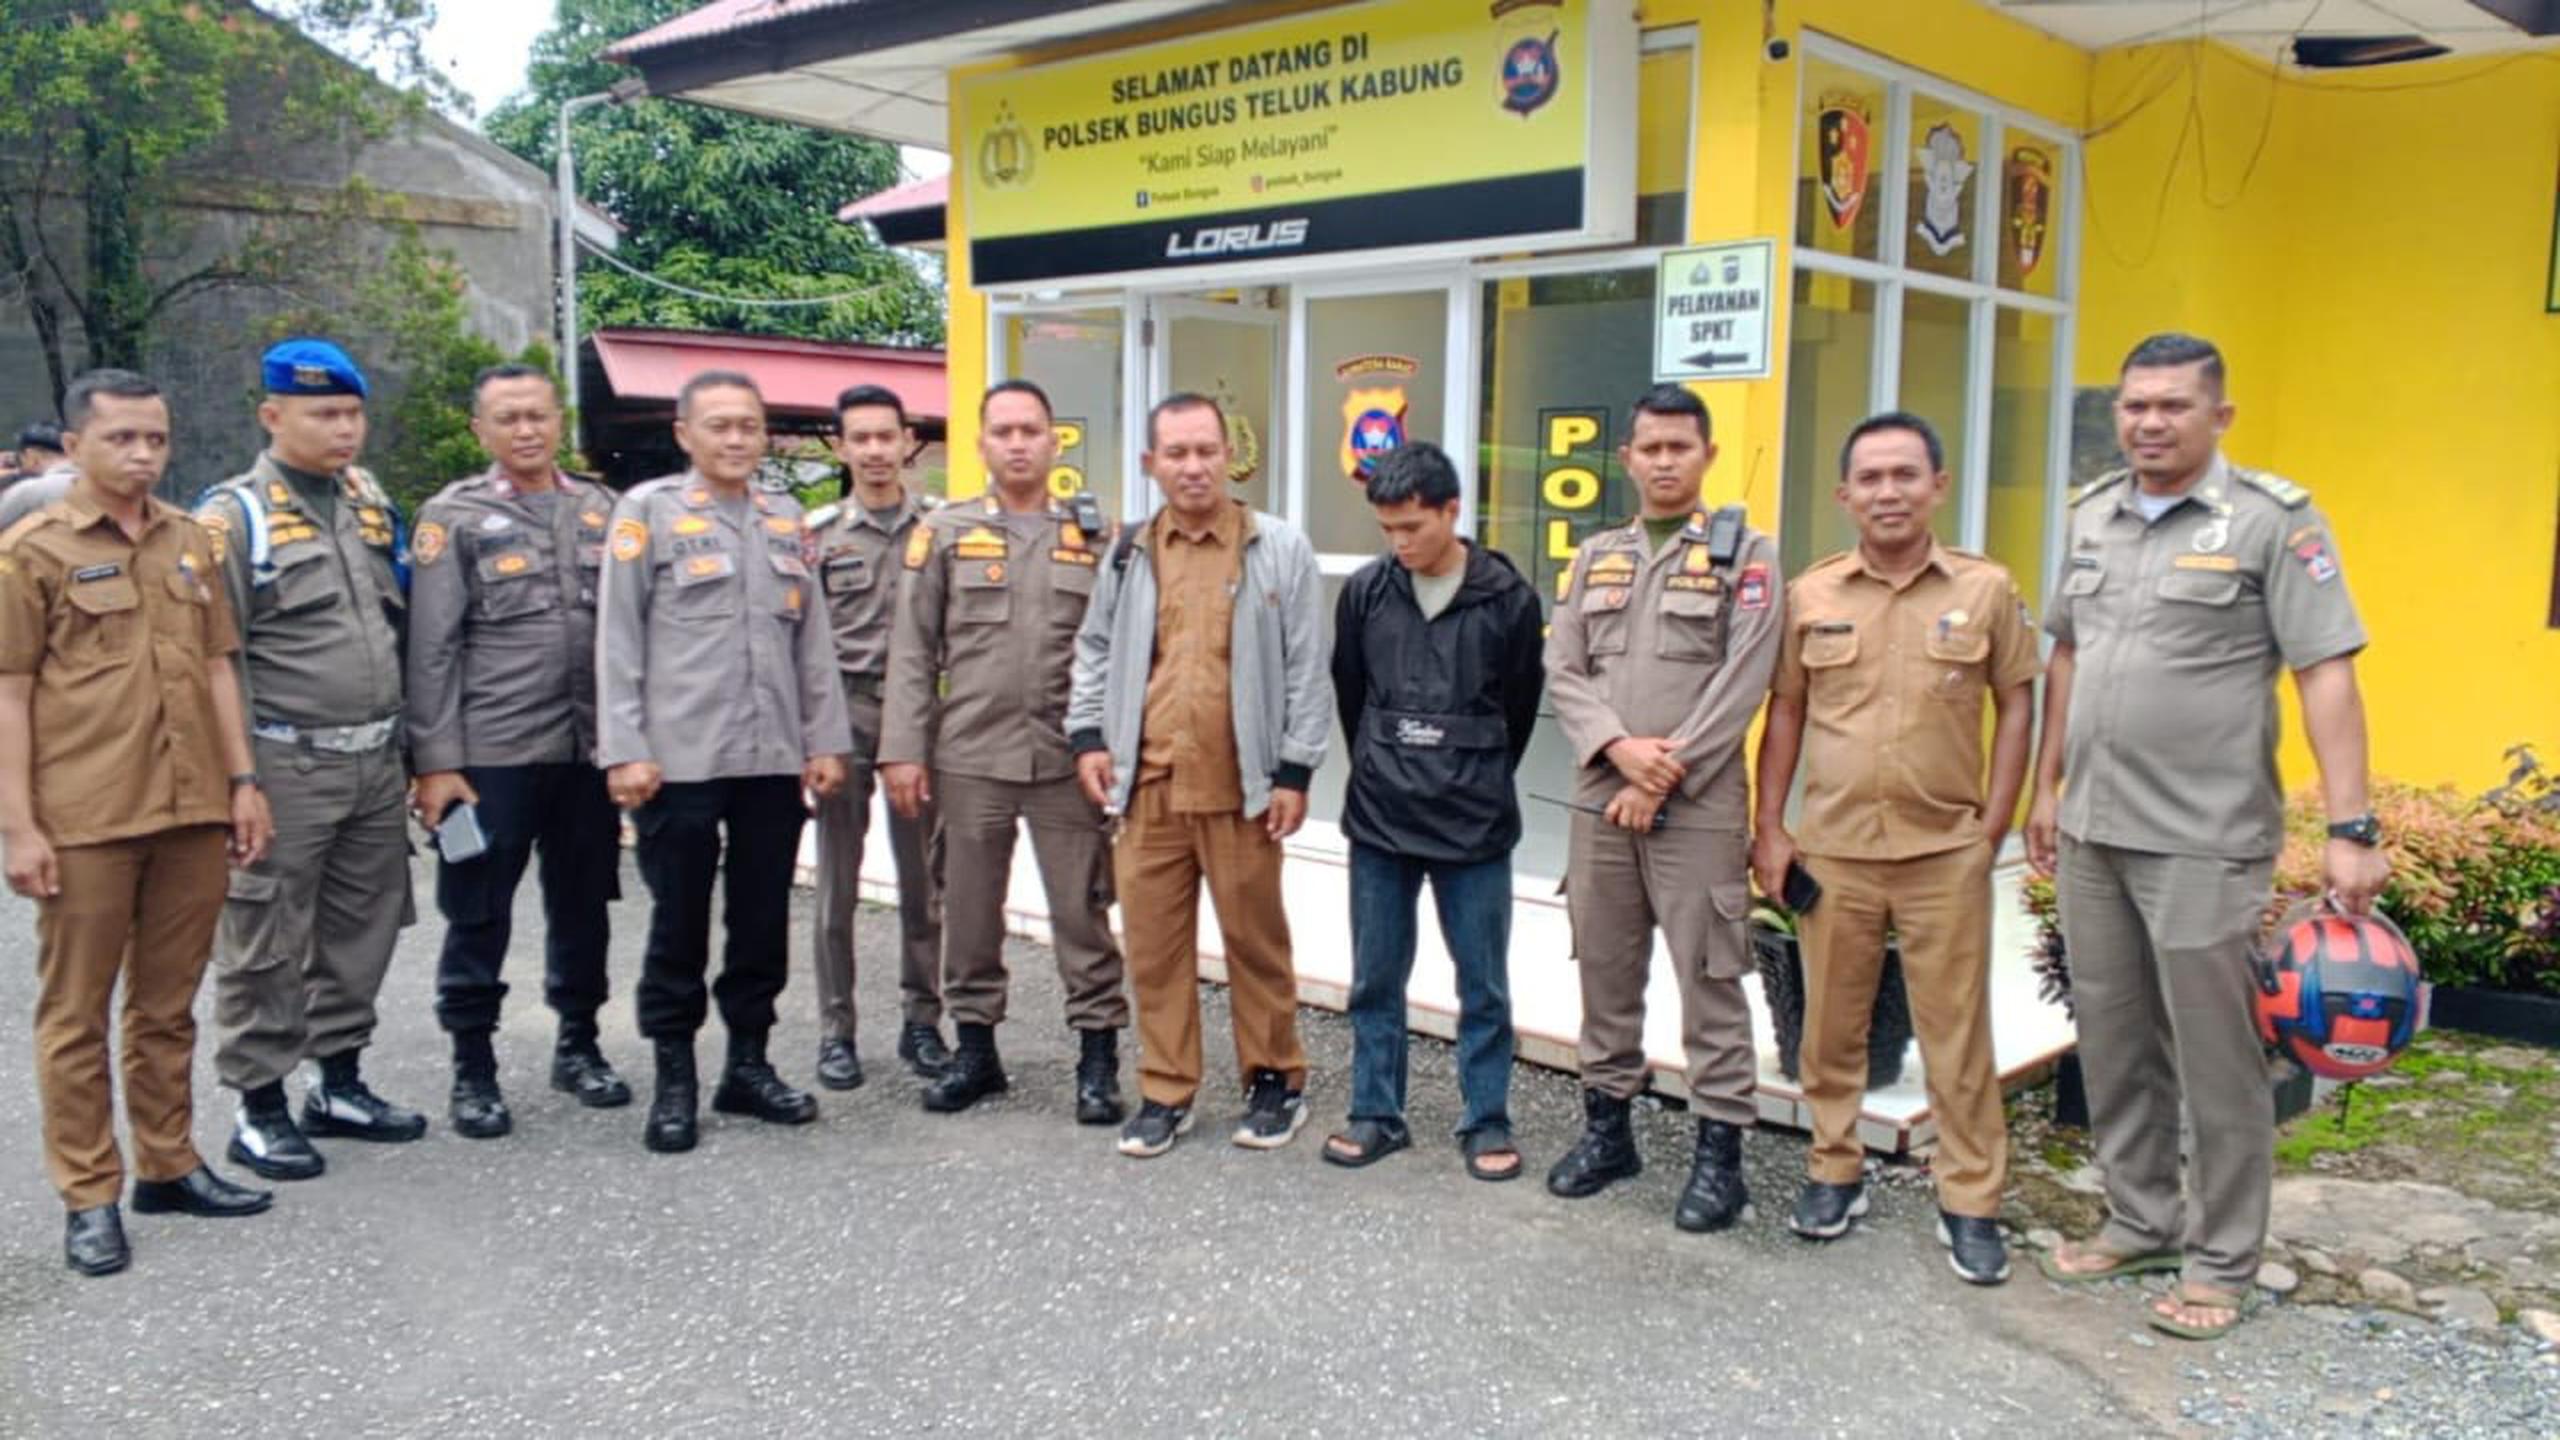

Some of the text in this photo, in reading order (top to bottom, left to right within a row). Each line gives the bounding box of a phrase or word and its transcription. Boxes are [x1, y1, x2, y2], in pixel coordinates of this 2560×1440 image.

[1111, 32, 1369, 104] SELAMAT DATANG DI
[1043, 56, 1464, 151] POLSEK BUNGUS TELUK KABUNG
[1197, 143, 1237, 168] Siap
[1165, 217, 1310, 258] LORUS
[1667, 288, 1761, 318] PELAYANAN
[1690, 319, 1737, 344] SPKT
